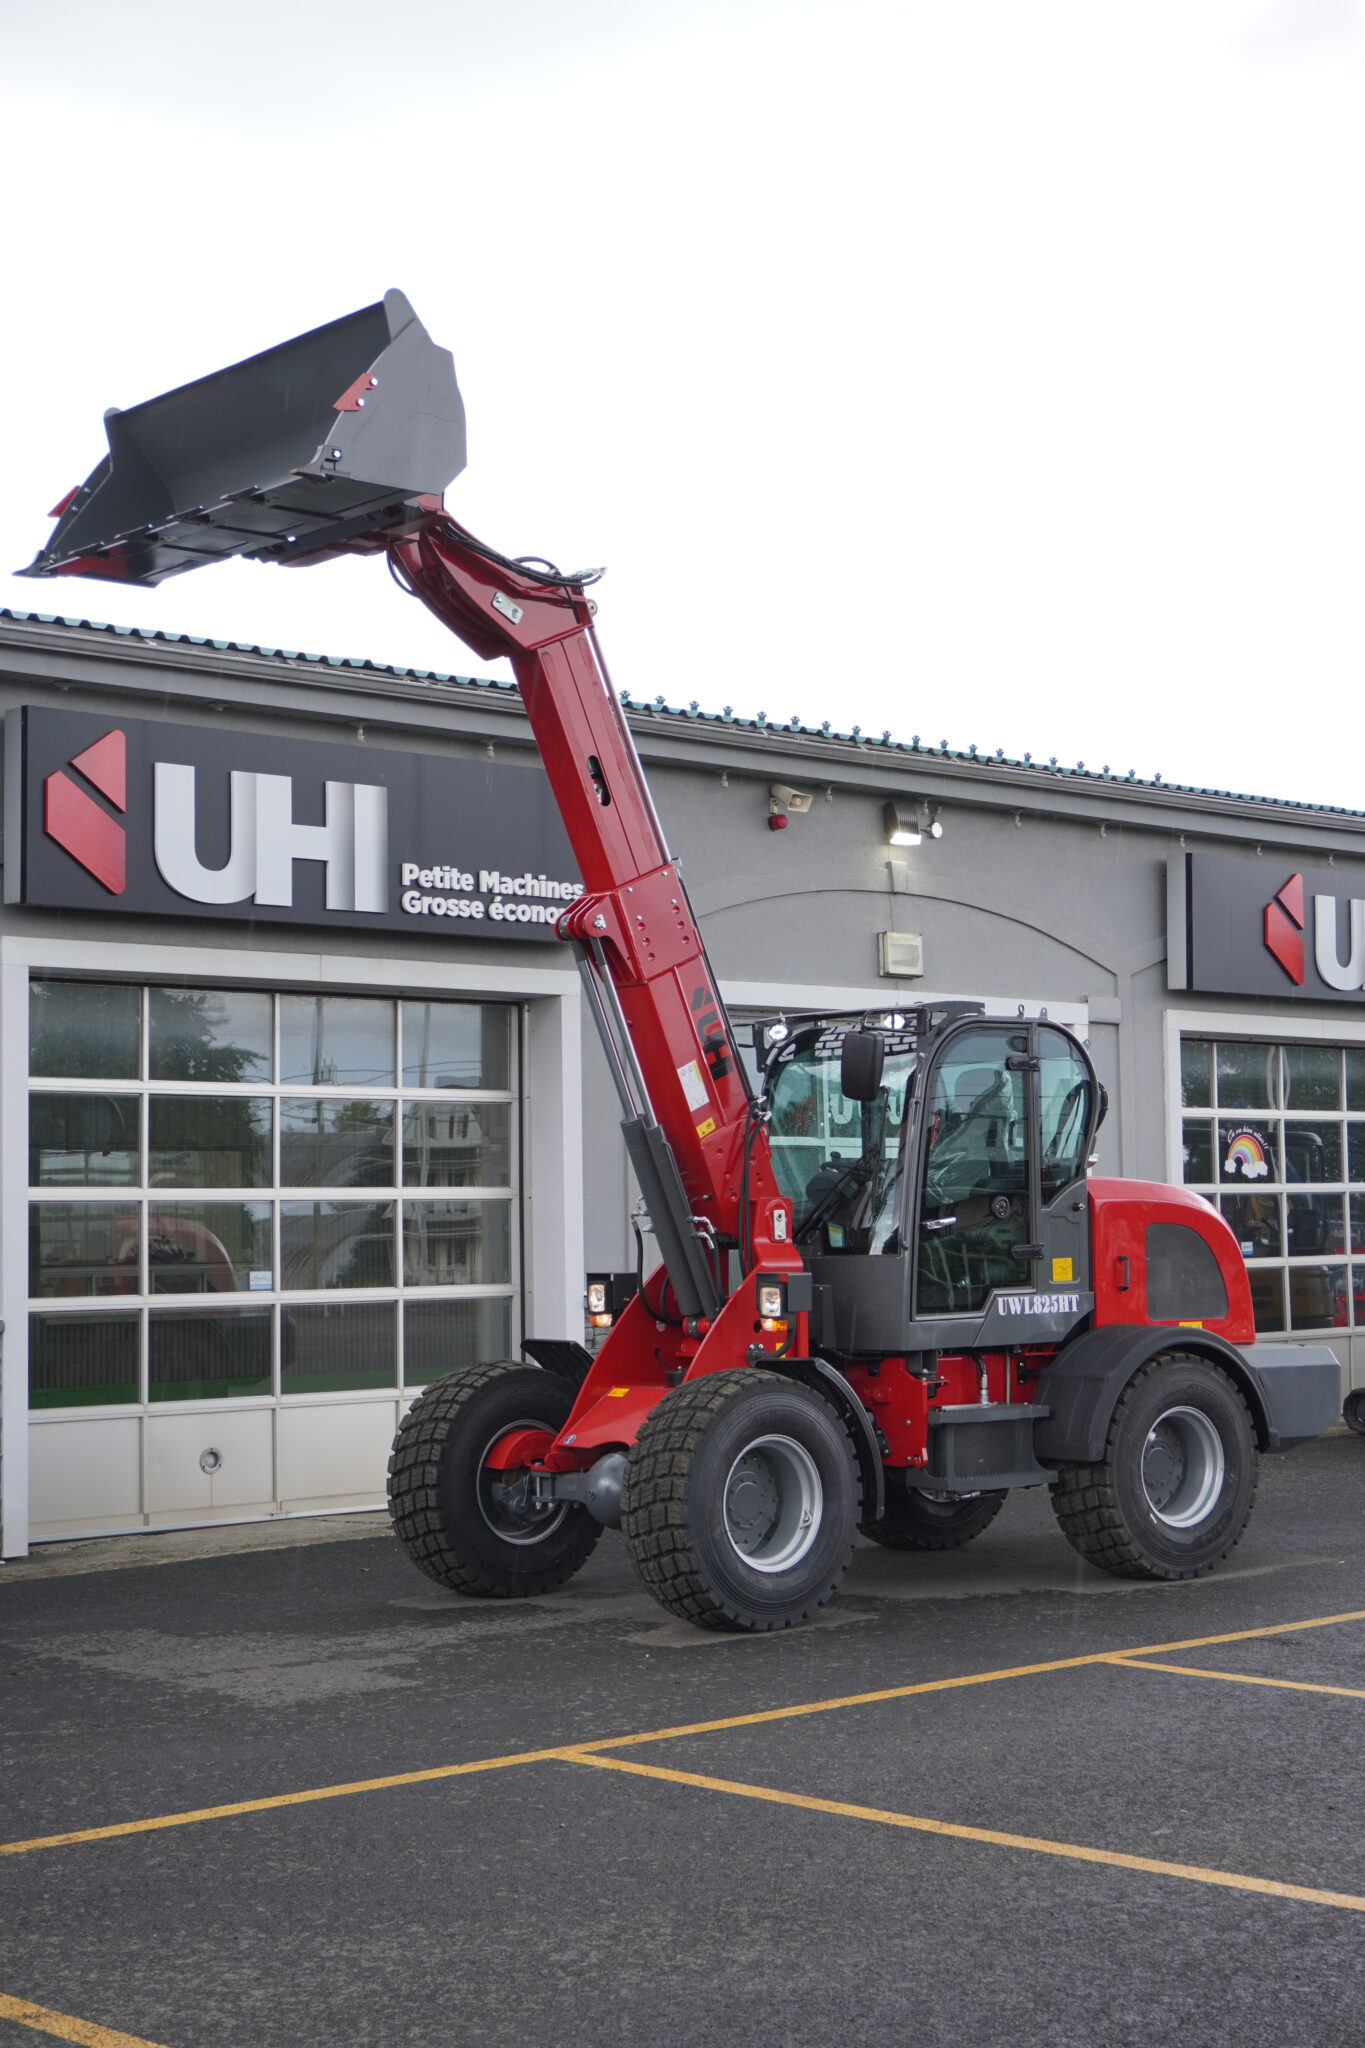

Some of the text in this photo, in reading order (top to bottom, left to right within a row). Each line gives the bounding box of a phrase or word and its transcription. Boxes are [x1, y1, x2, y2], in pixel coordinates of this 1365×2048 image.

[402, 863, 584, 900] Petite Machines
[402, 890, 567, 924] Grosse écono
[997, 1294, 1080, 1316] UWL825HT
